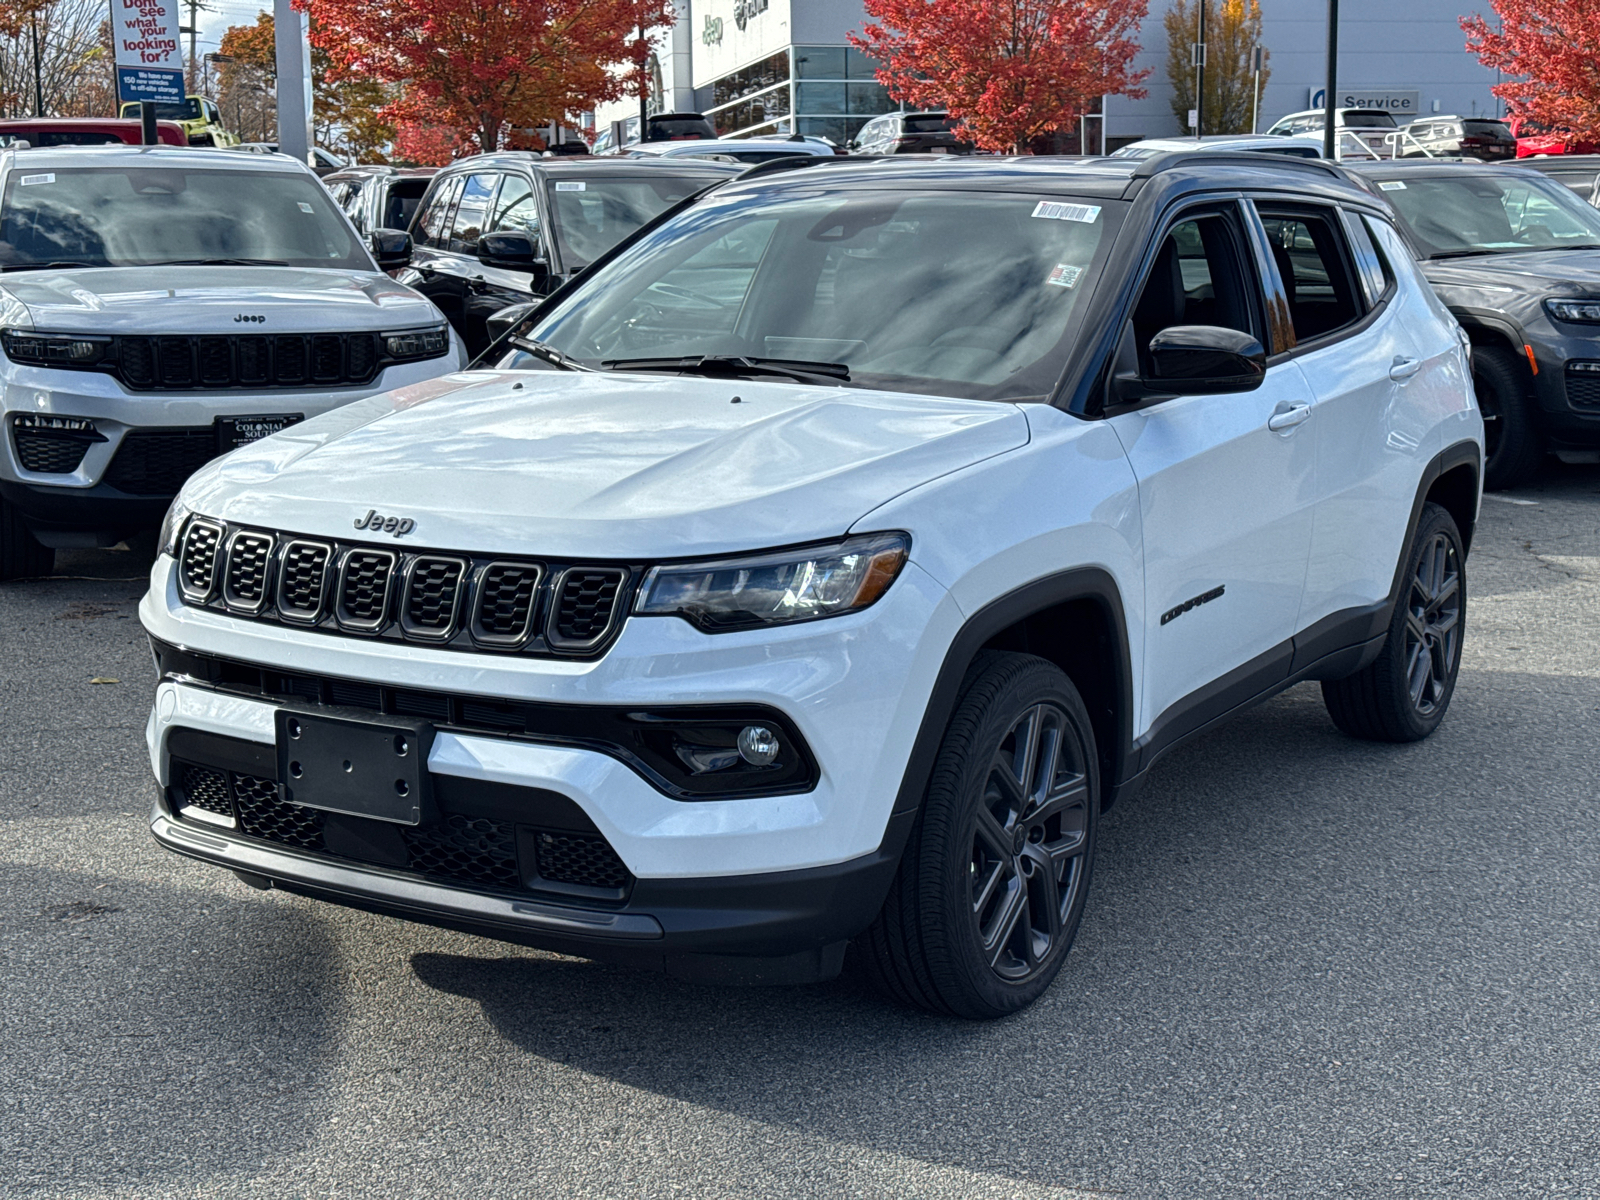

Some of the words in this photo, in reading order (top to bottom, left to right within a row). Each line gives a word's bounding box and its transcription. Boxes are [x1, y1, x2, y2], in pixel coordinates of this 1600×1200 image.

[139, 7, 166, 17] see
[124, 17, 158, 29] what
[139, 27, 167, 39] your
[123, 37, 176, 51] looking
[140, 50, 170, 63] for?
[123, 76, 136, 84] 150
[1344, 96, 1411, 108] Service
[233, 313, 266, 324] Jeep
[353, 509, 415, 538] Jeep
